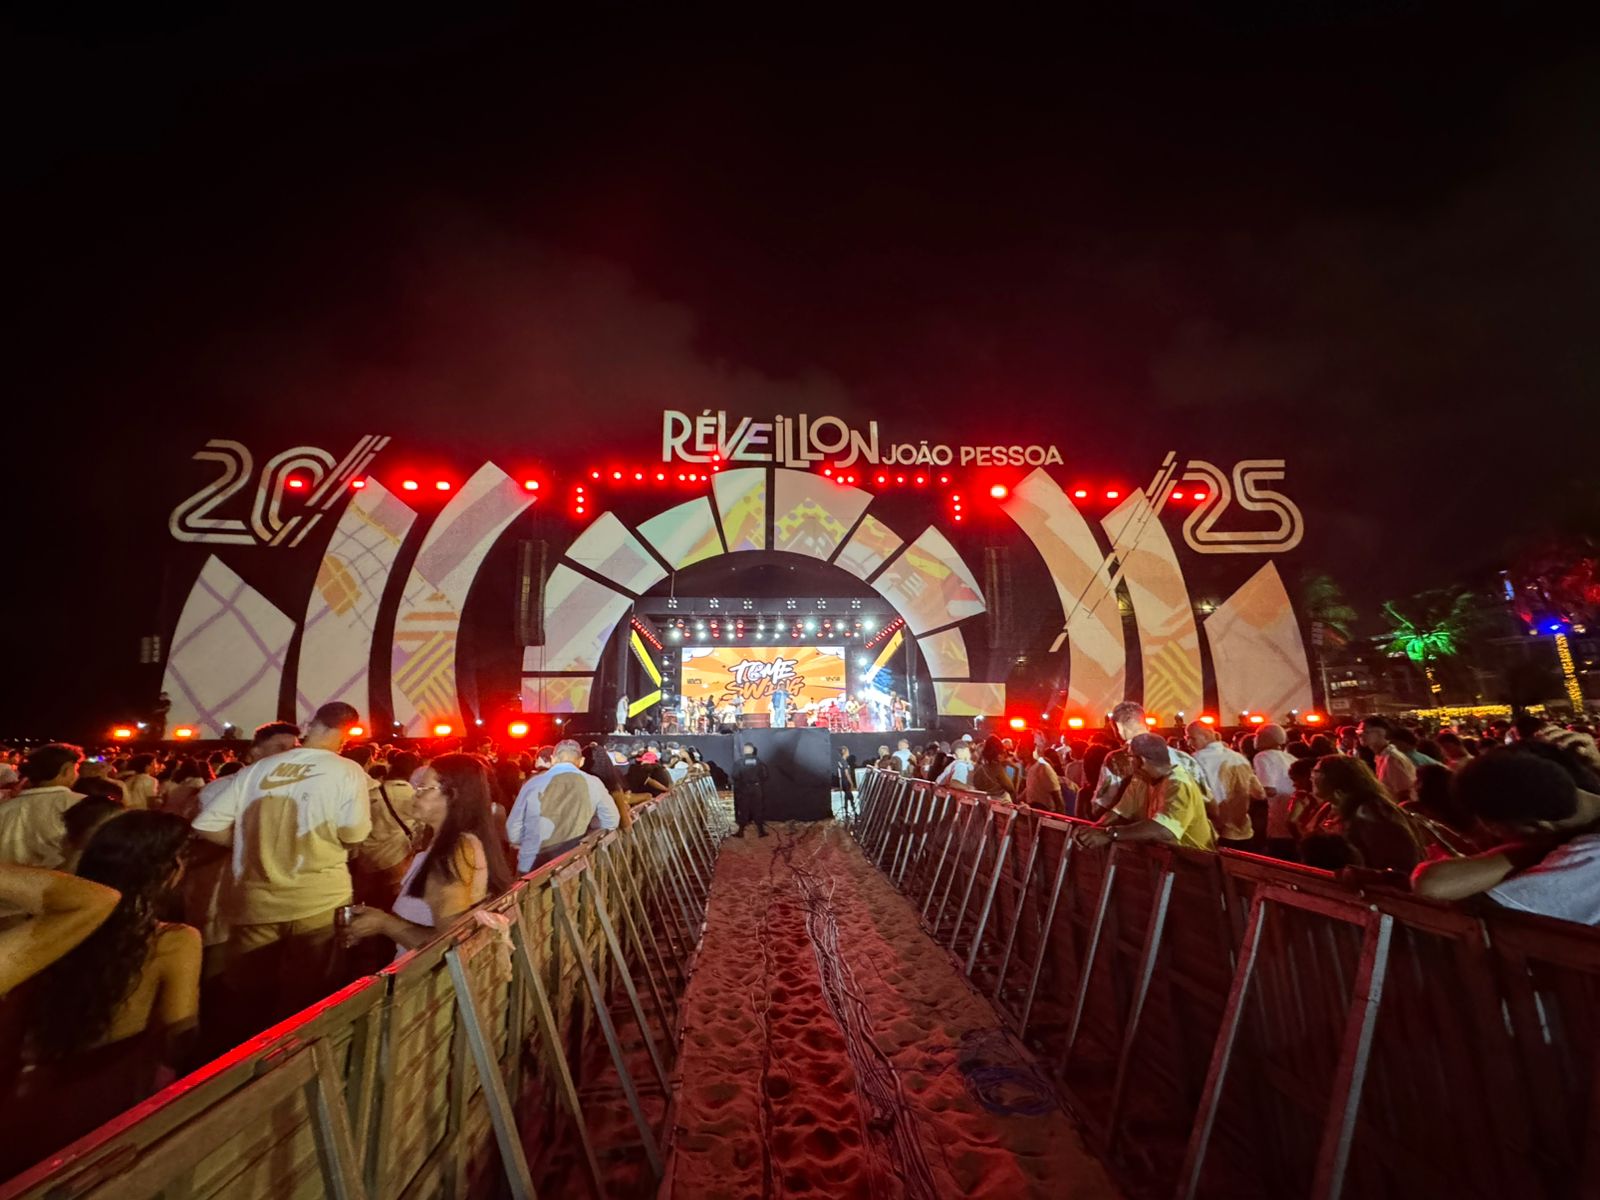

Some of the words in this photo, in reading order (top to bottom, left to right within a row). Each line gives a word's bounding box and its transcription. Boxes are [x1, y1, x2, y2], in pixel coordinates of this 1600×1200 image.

[882, 440, 953, 466] JOÃO
[960, 444, 1064, 467] PESSOA
[269, 762, 316, 777] NIKE
